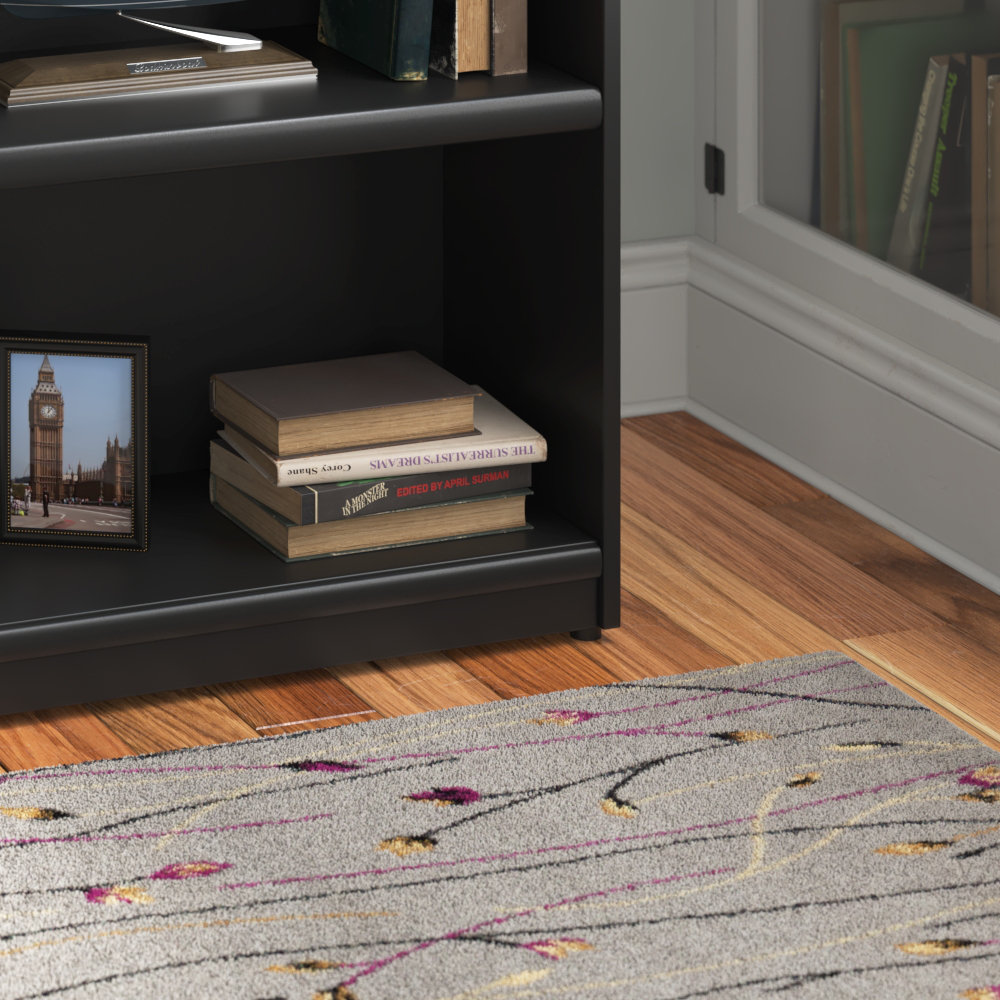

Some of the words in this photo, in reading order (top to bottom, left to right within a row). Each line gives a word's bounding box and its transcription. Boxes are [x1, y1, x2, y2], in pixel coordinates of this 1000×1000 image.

[423, 447, 509, 464] SURREALIST'S
[511, 444, 536, 456] THE
[320, 464, 352, 473] Corey
[369, 456, 421, 470] DREAMS
[287, 466, 319, 476] Shane
[396, 483, 429, 497] EDITED
[430, 481, 443, 492] BY
[443, 477, 470, 489] APRIL
[471, 470, 510, 485] SURMAN
[351, 481, 386, 504] MONSTER
[342, 506, 351, 516] IN
[351, 501, 367, 514] THE
[366, 487, 389, 505] NIGHT
